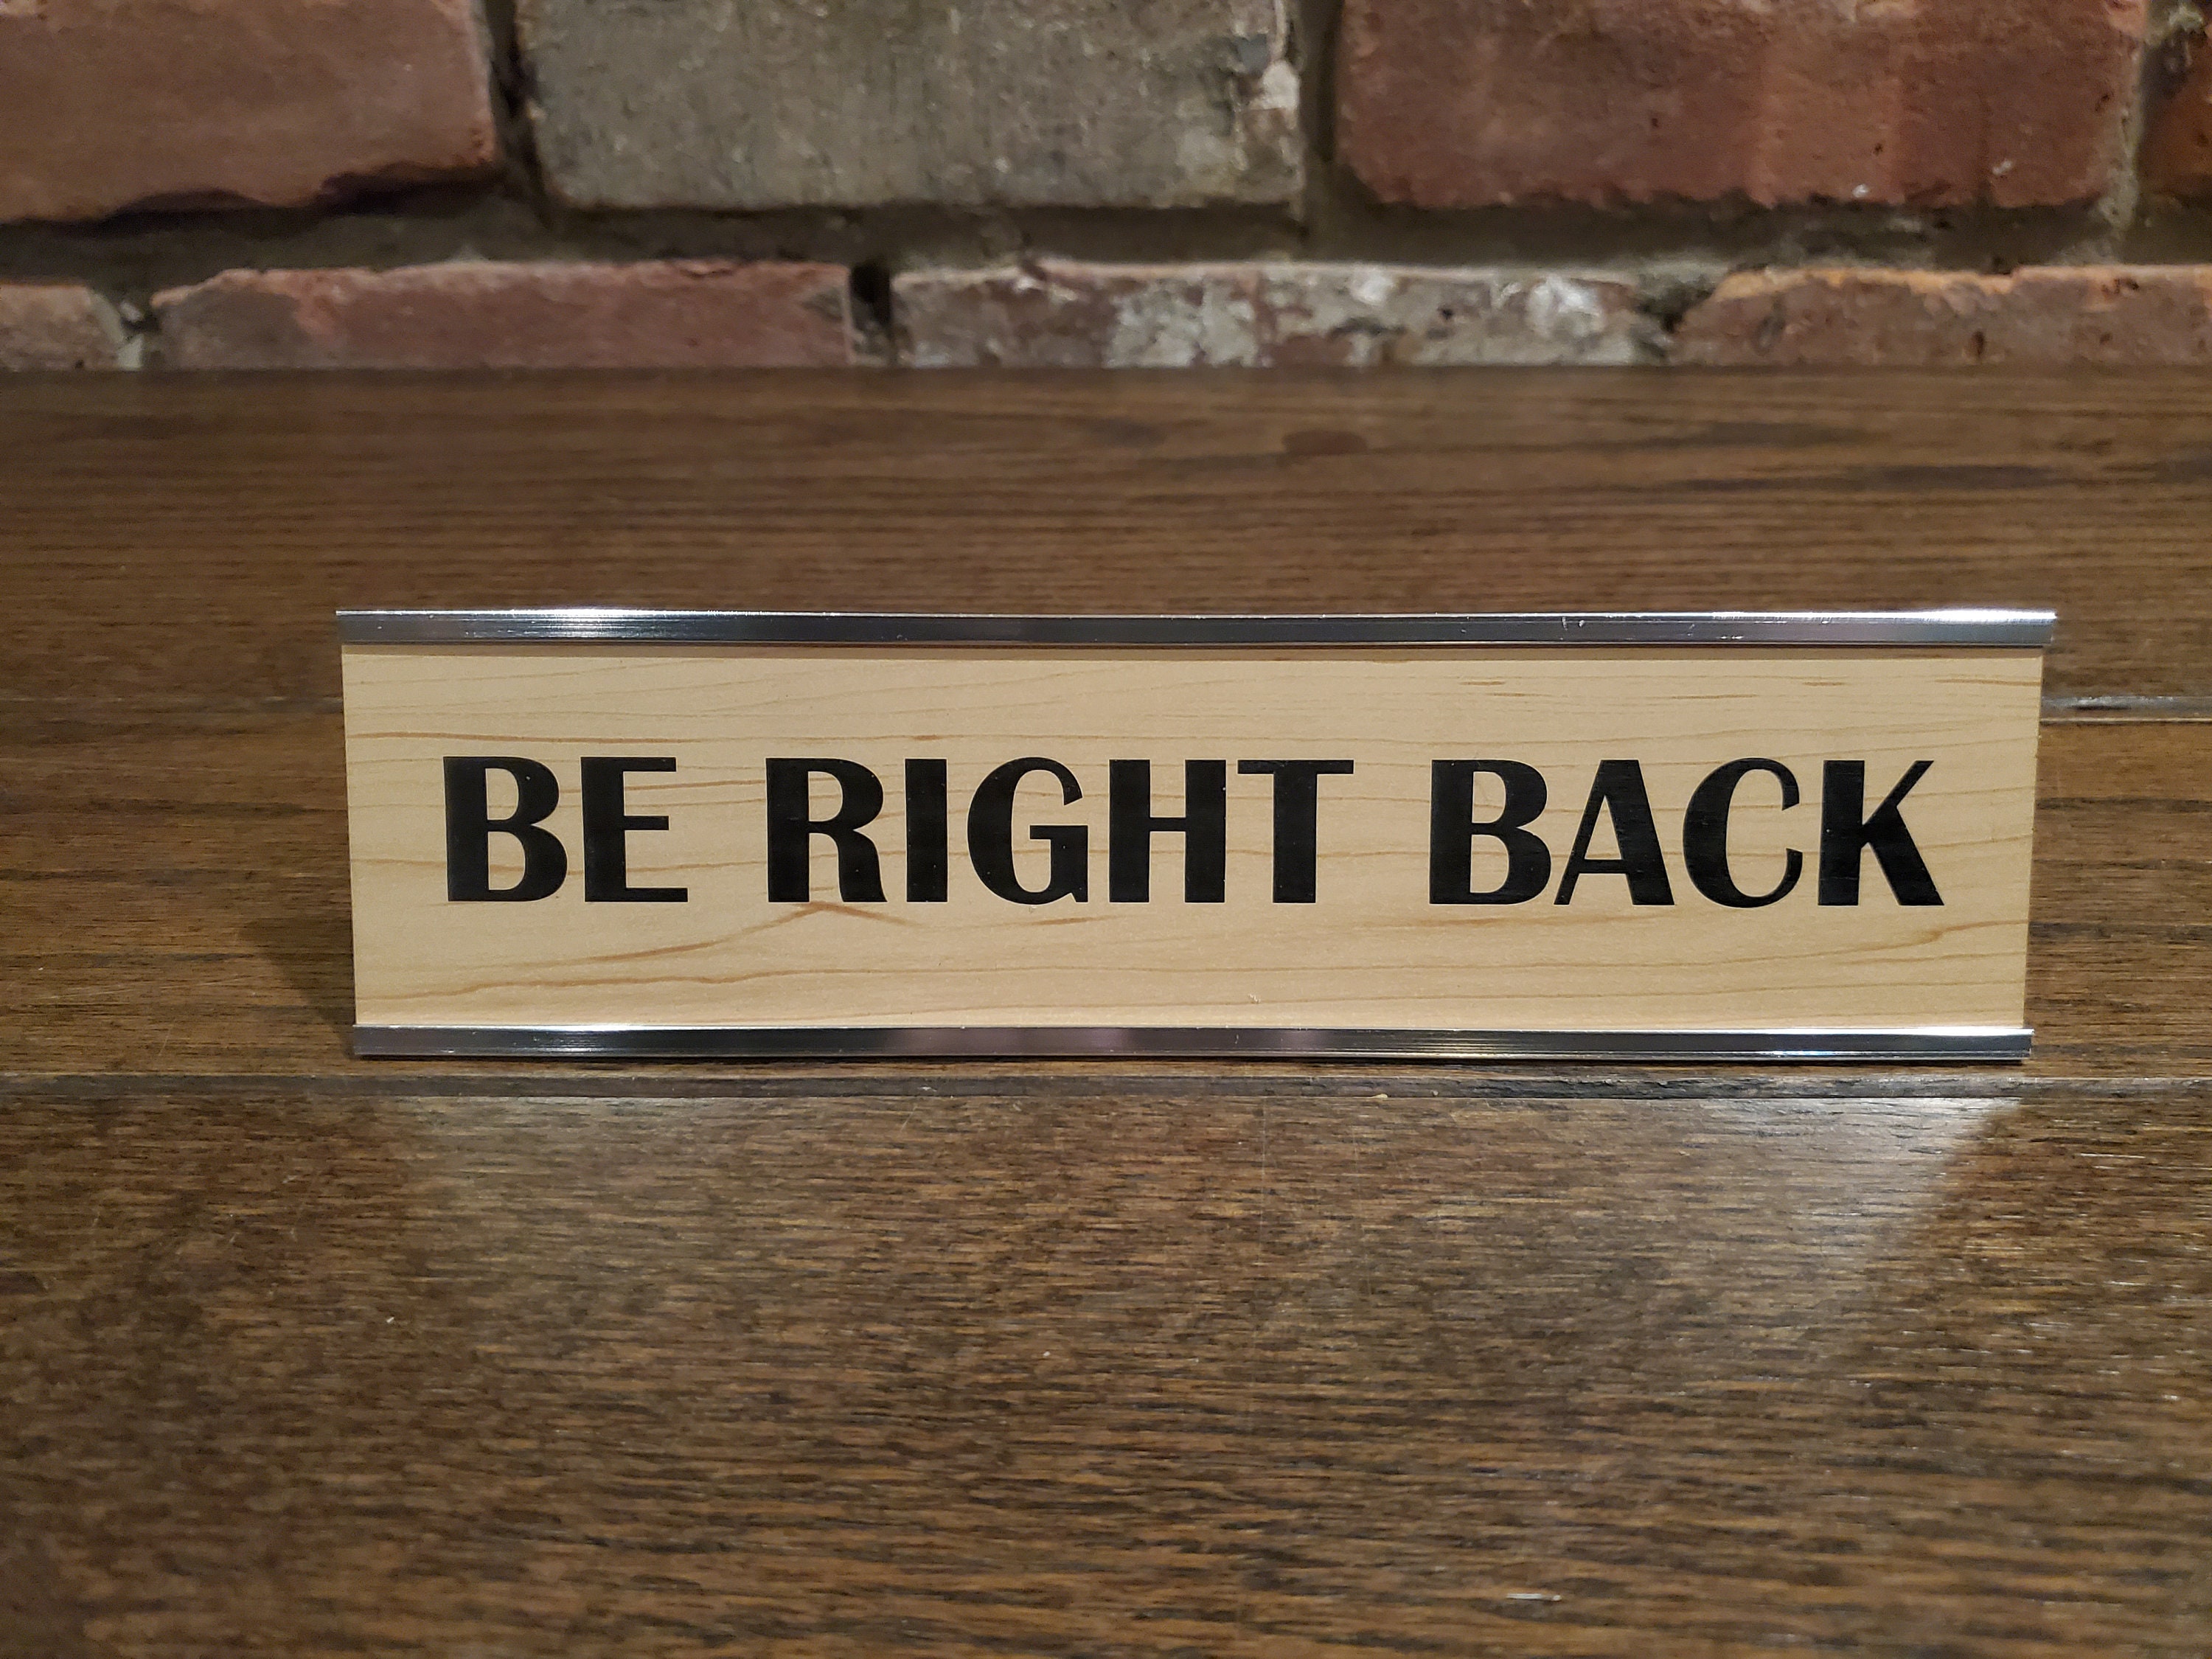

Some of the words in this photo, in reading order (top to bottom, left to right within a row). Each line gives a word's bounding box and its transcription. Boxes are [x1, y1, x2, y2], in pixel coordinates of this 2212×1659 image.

[443, 756, 689, 902] BE
[766, 757, 1354, 905] RIGHT
[1429, 757, 1945, 908] BACK
